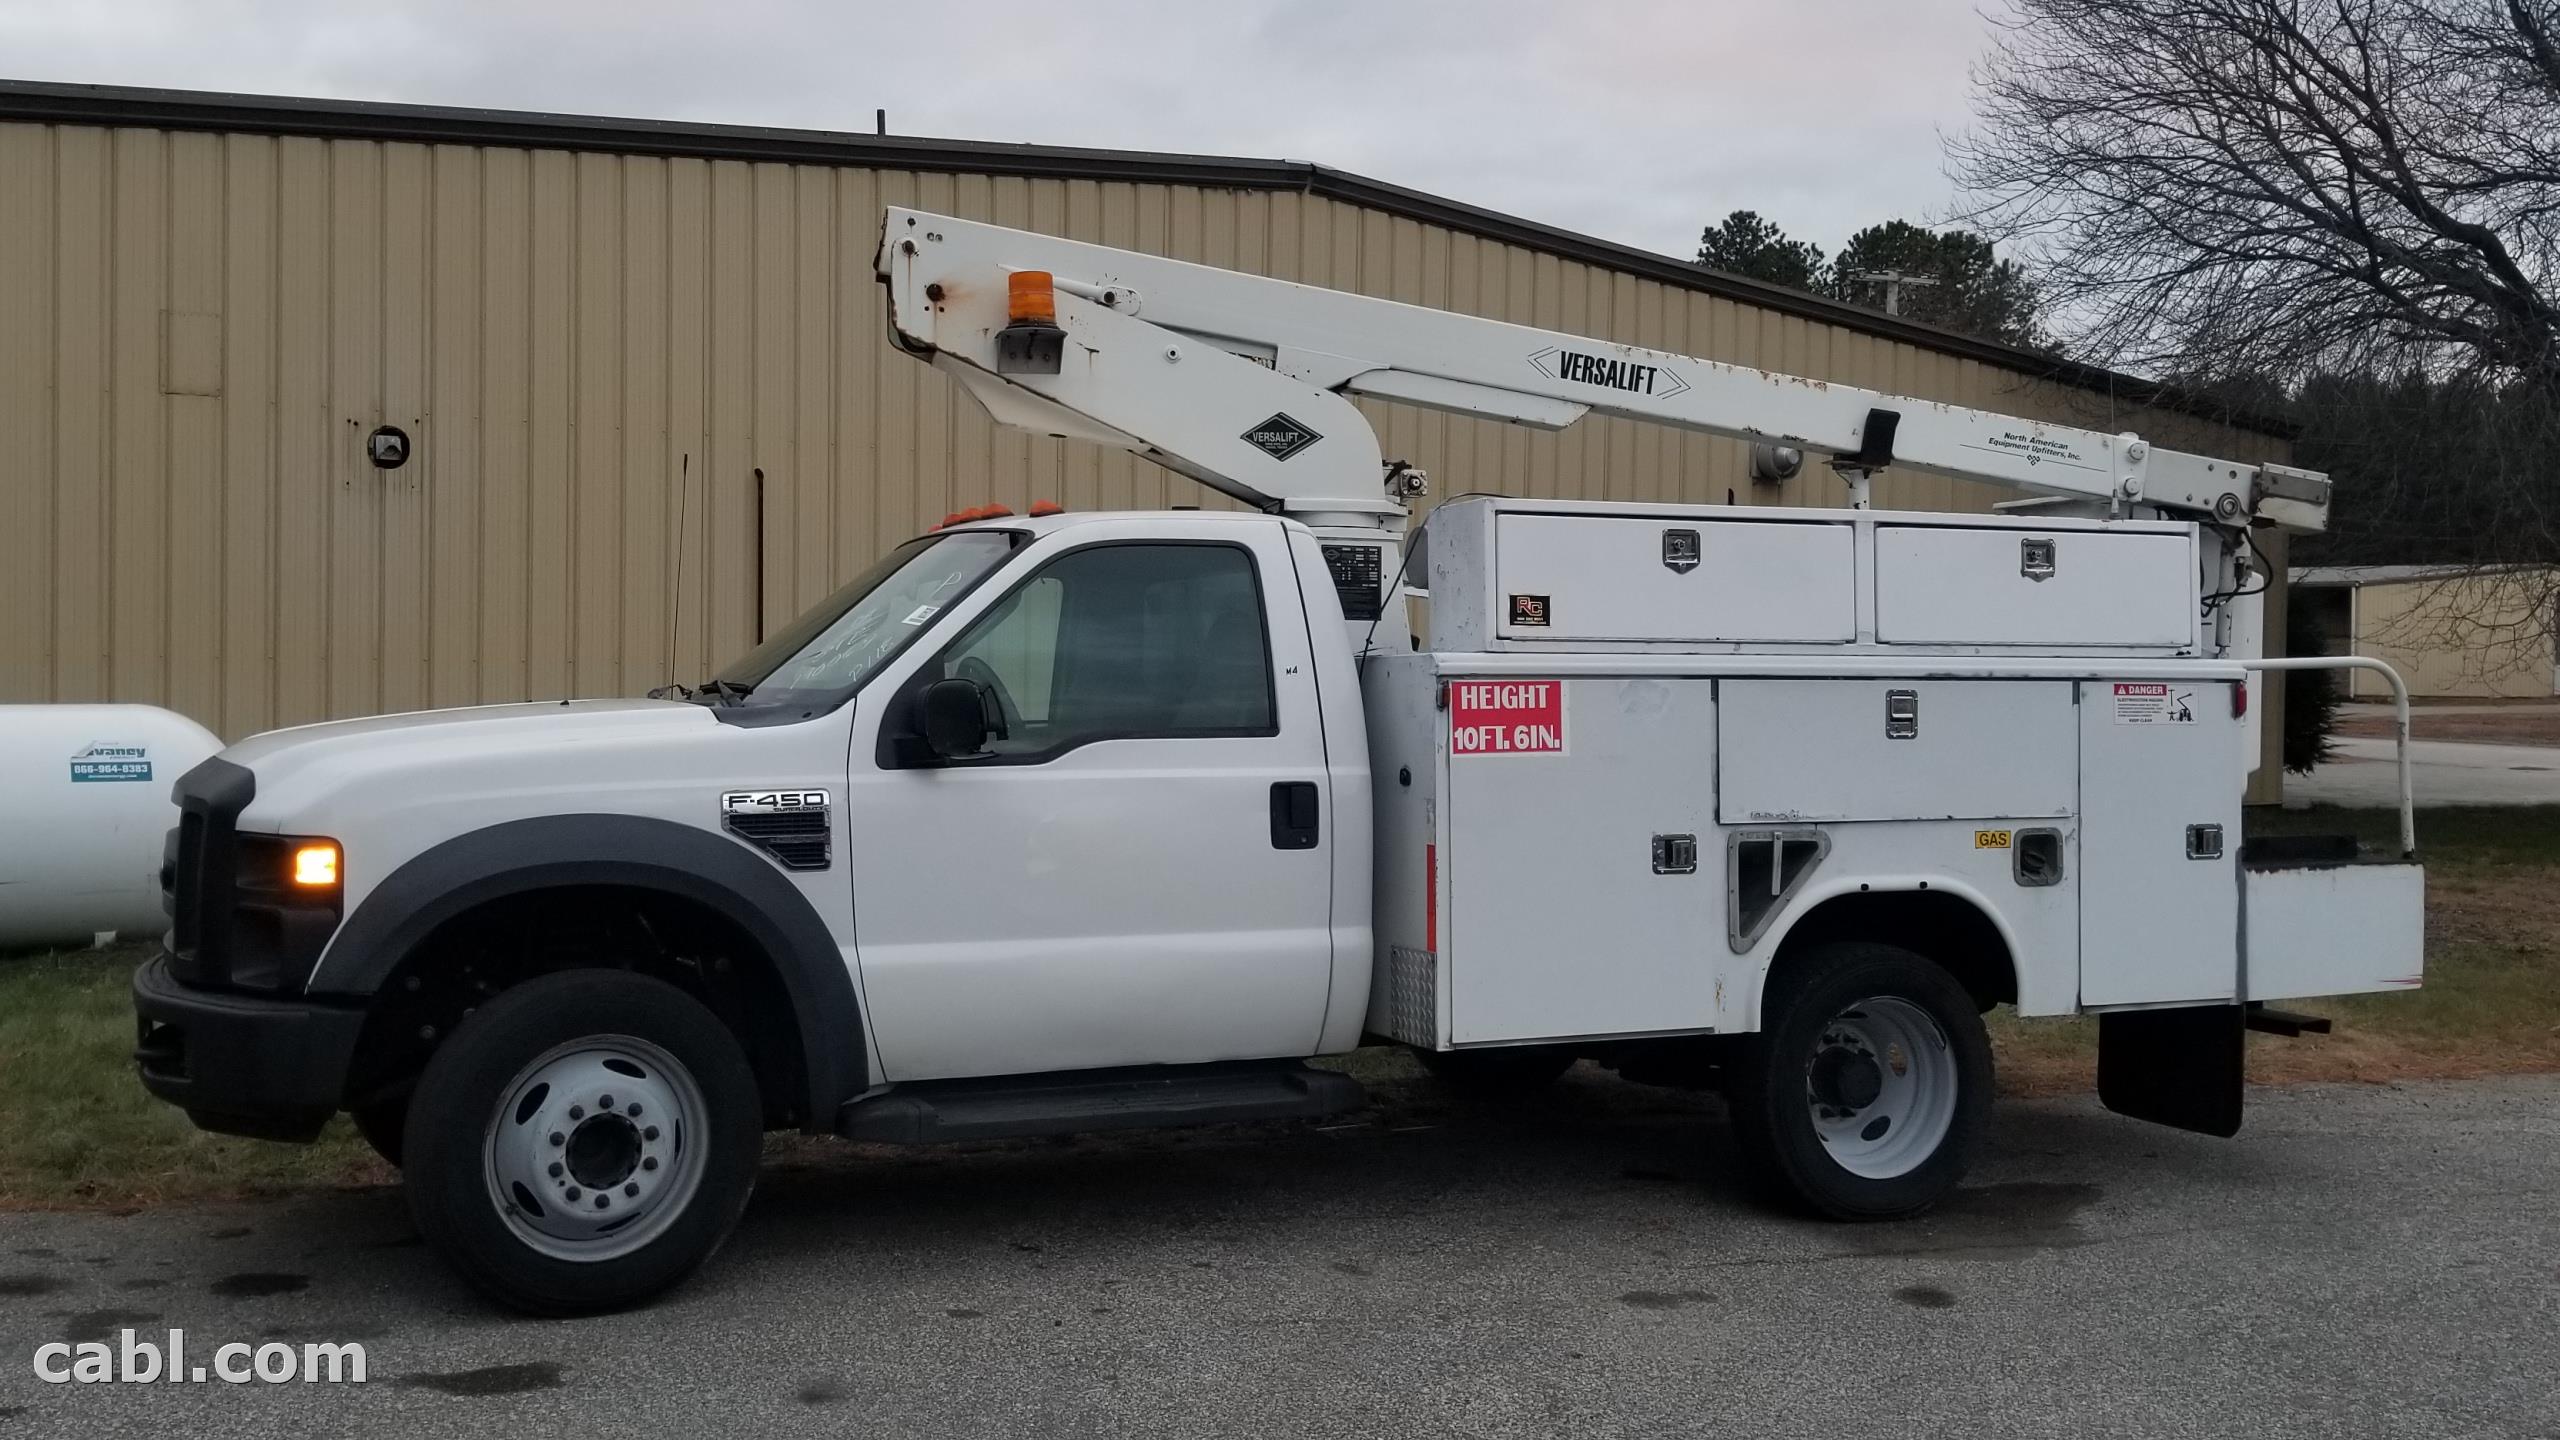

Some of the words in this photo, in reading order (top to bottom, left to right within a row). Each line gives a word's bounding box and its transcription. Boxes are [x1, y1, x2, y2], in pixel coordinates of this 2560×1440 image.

[1560, 350, 1658, 395] VERSALIFT
[1252, 431, 1299, 443] VERSALIFT
[2004, 432, 2027, 443] North
[2029, 437, 2069, 450] American
[1988, 437, 2030, 451] Equipment
[2031, 445, 2067, 459] Upfitters,
[2067, 452, 2082, 461] Inc.
[1461, 685, 1550, 710] HEIGHT
[2128, 685, 2164, 695] DANGER
[1454, 725, 1510, 751] 10FT.
[1513, 724, 1561, 750] 6IN.
[728, 792, 825, 809] F-450
[1979, 832, 2007, 847] GAS
